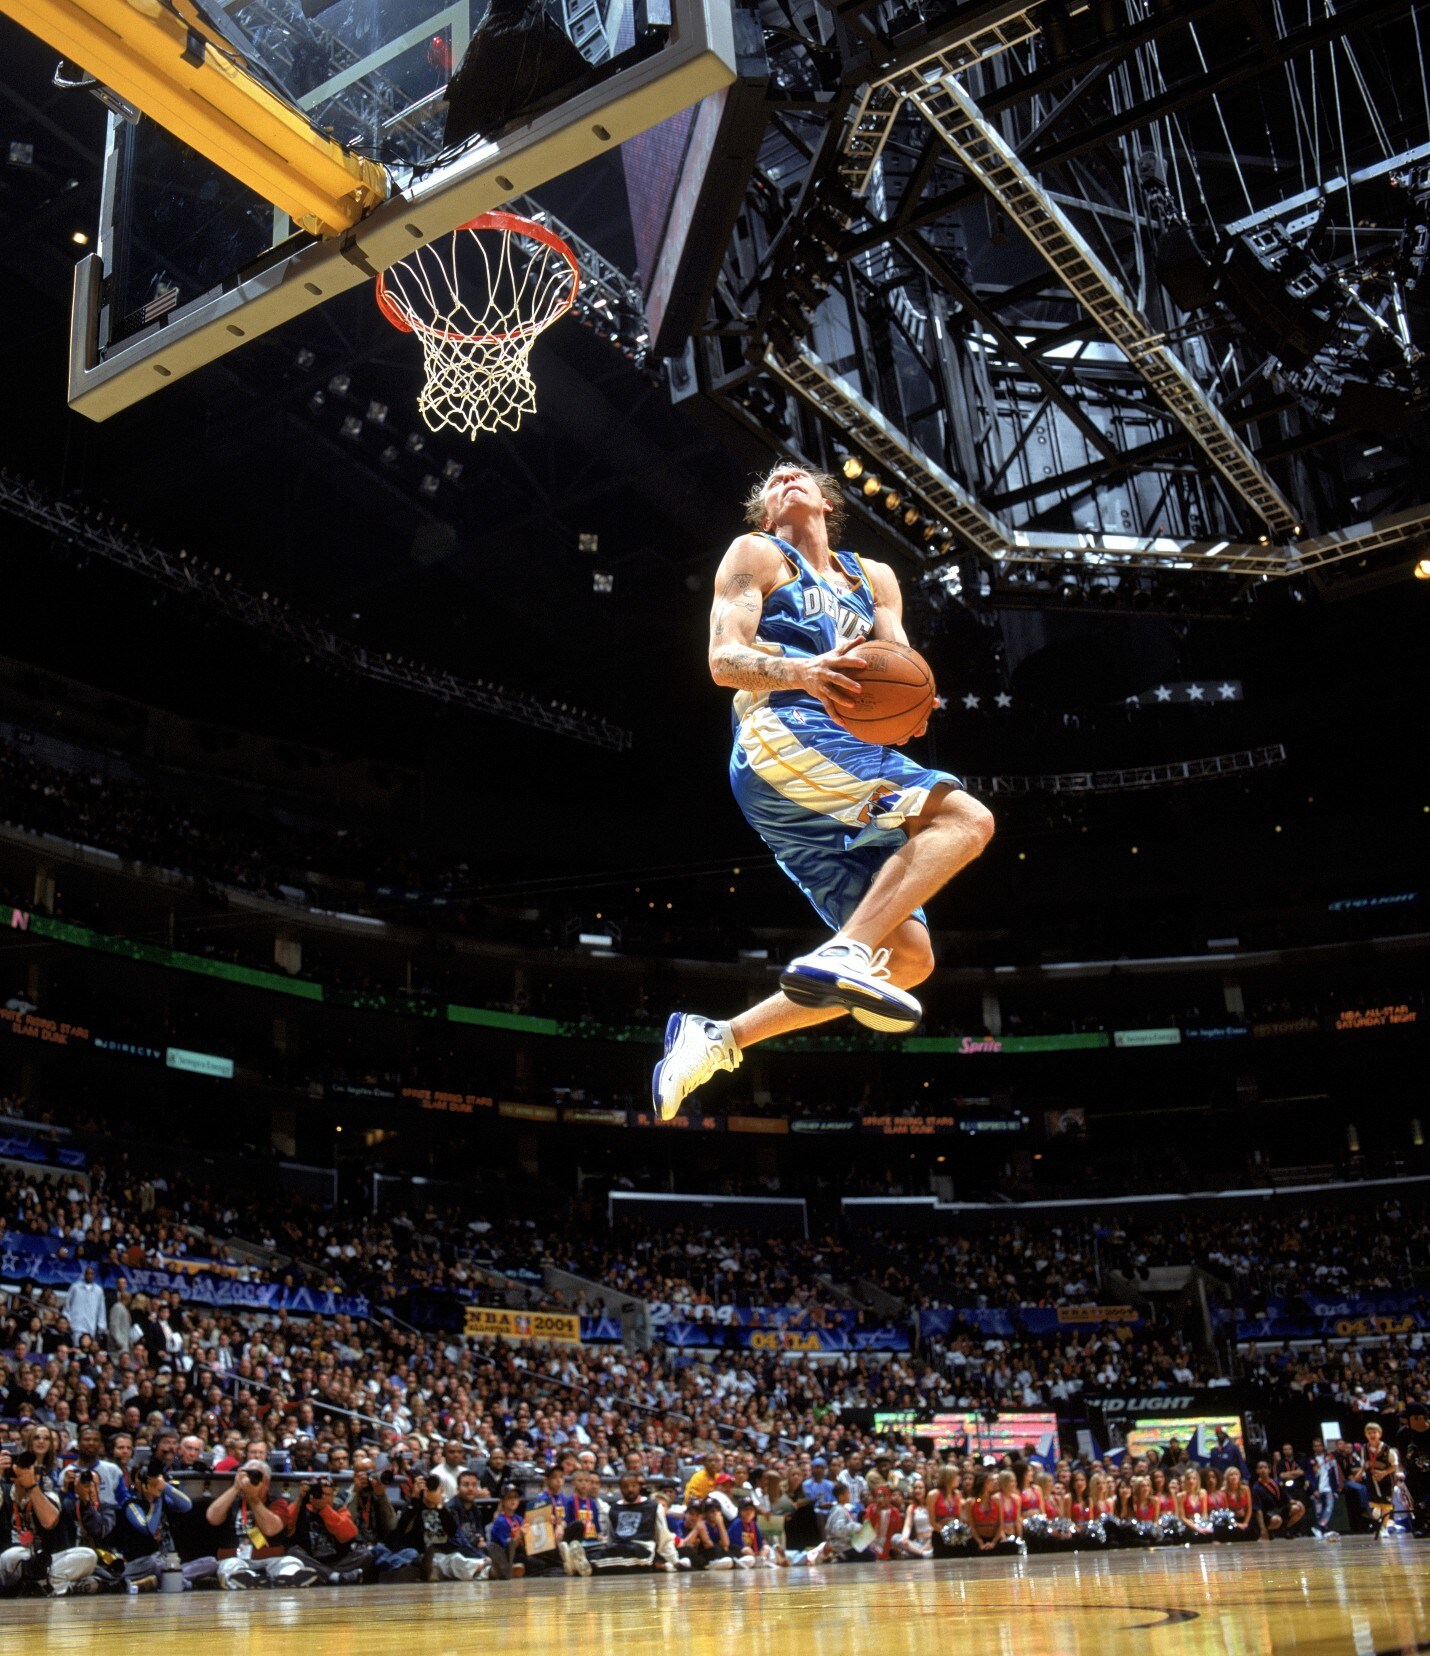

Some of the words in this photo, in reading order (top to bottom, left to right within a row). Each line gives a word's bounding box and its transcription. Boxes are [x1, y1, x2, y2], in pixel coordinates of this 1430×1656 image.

[12, 1022, 39, 1038] SLAM
[41, 1028, 68, 1045] DUNK
[958, 1037, 1002, 1054] Sprite
[470, 1311, 511, 1325] NBA
[533, 1316, 575, 1332] 2004
[1126, 1395, 1195, 1411] LIGHT
